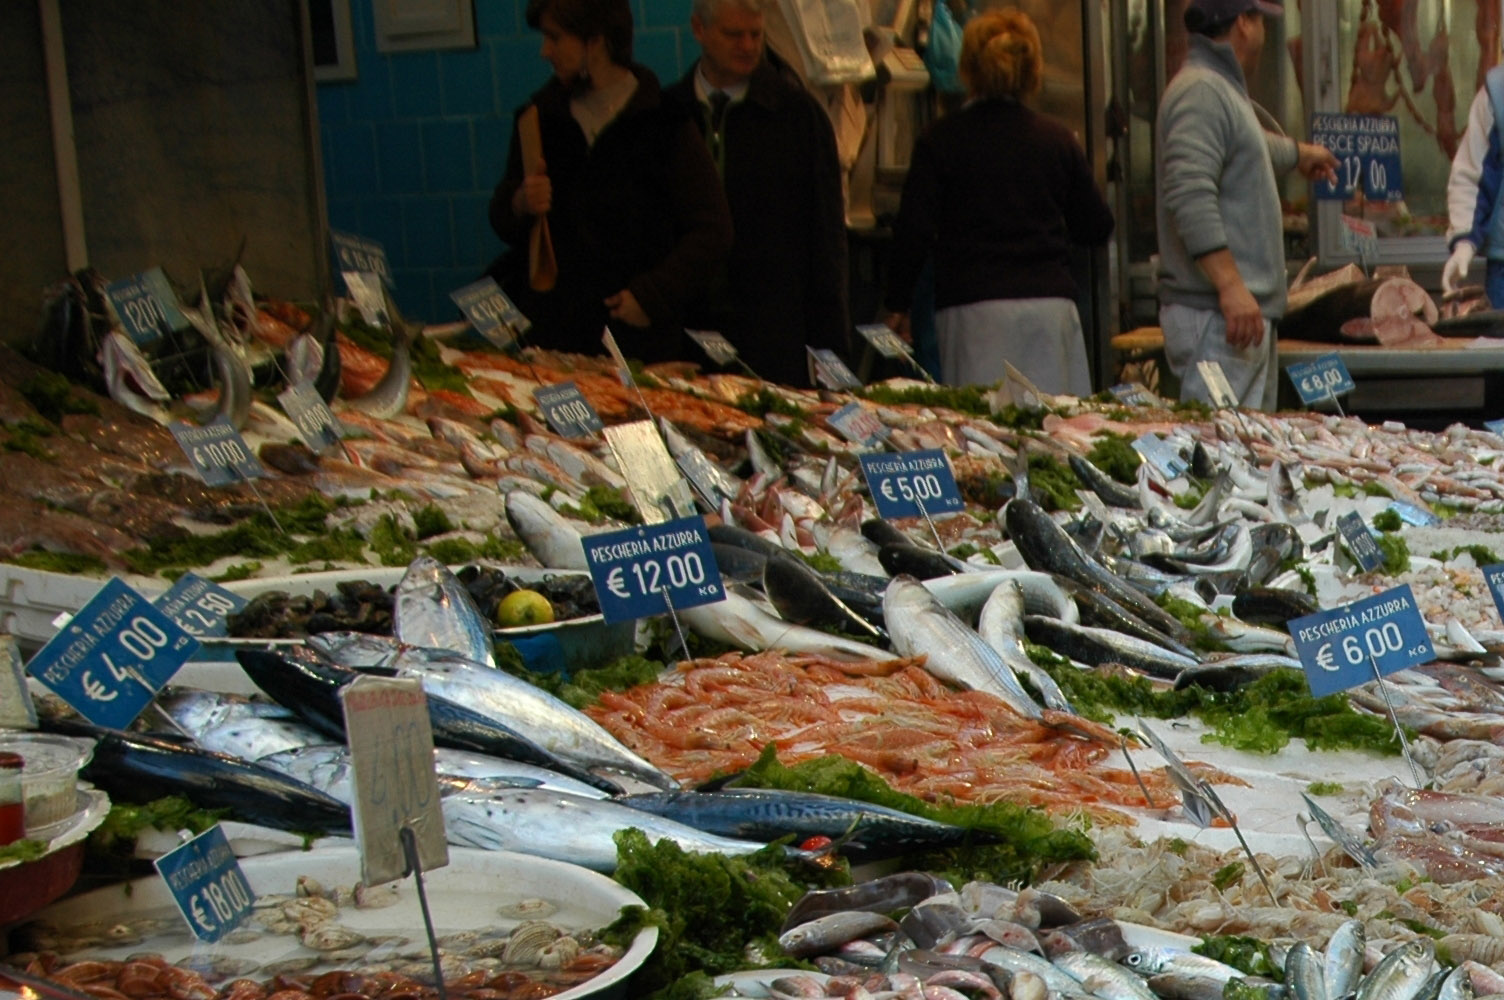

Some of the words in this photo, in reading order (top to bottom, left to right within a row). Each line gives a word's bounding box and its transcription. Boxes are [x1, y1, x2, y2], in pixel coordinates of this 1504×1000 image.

[1313, 134, 1354, 153] PESCE
[1357, 135, 1399, 153] SPADA
[590, 539, 652, 564] PESCHERIA
[653, 529, 703, 552] AZZURRA
[698, 584, 719, 597] KG
[1298, 614, 1360, 643] PESCHERIA
[1361, 596, 1411, 624] AZZURRA
[43, 631, 99, 686] PESCHERIA
[92, 592, 138, 638] AZZURRA
[1408, 644, 1428, 657] KG
